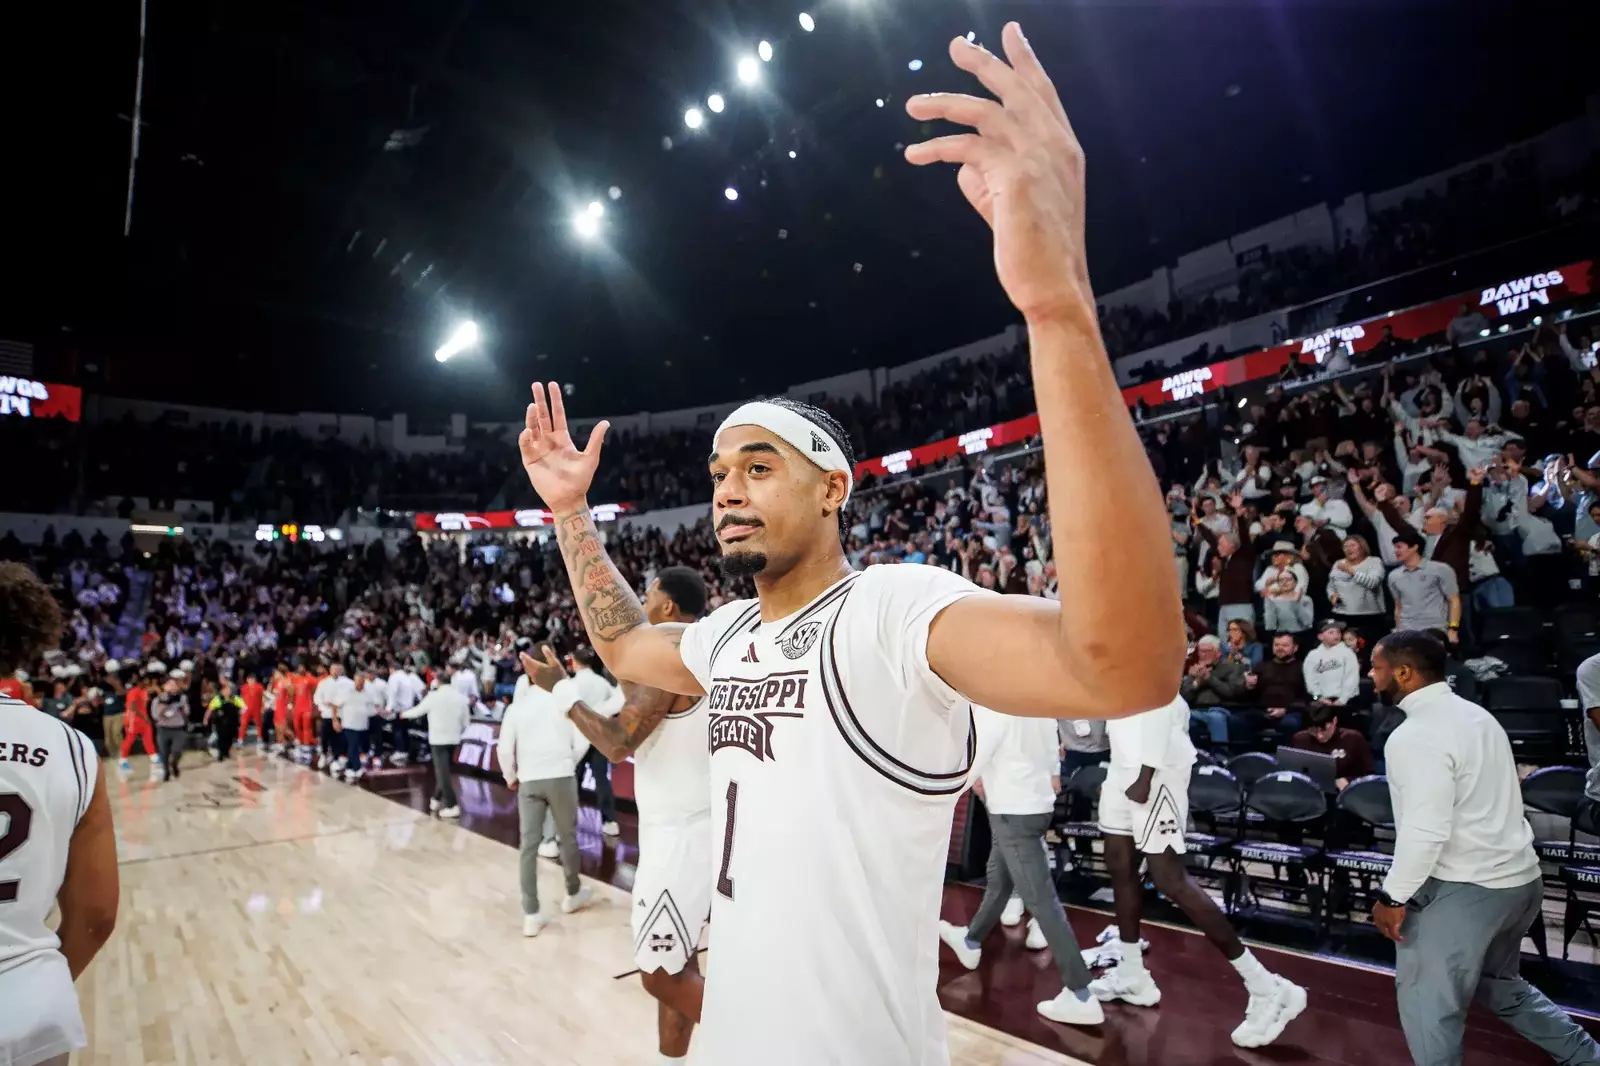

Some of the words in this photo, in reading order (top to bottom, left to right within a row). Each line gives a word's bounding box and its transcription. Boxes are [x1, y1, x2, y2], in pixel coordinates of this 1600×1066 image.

[1480, 270, 1564, 306] DAWGS
[1497, 288, 1549, 316] WIN
[1161, 367, 1212, 392] DAWGS
[1172, 381, 1204, 401] WIN
[709, 678, 808, 711] ISSISSIPPI
[712, 719, 757, 751] STATE
[717, 778, 738, 901] 1
[1542, 847, 1569, 858] HAIL
[1241, 849, 1263, 859] HAIL
[1263, 852, 1289, 863] STATE
[1336, 858, 1359, 868] HAIL
[1360, 859, 1391, 873] STATE
